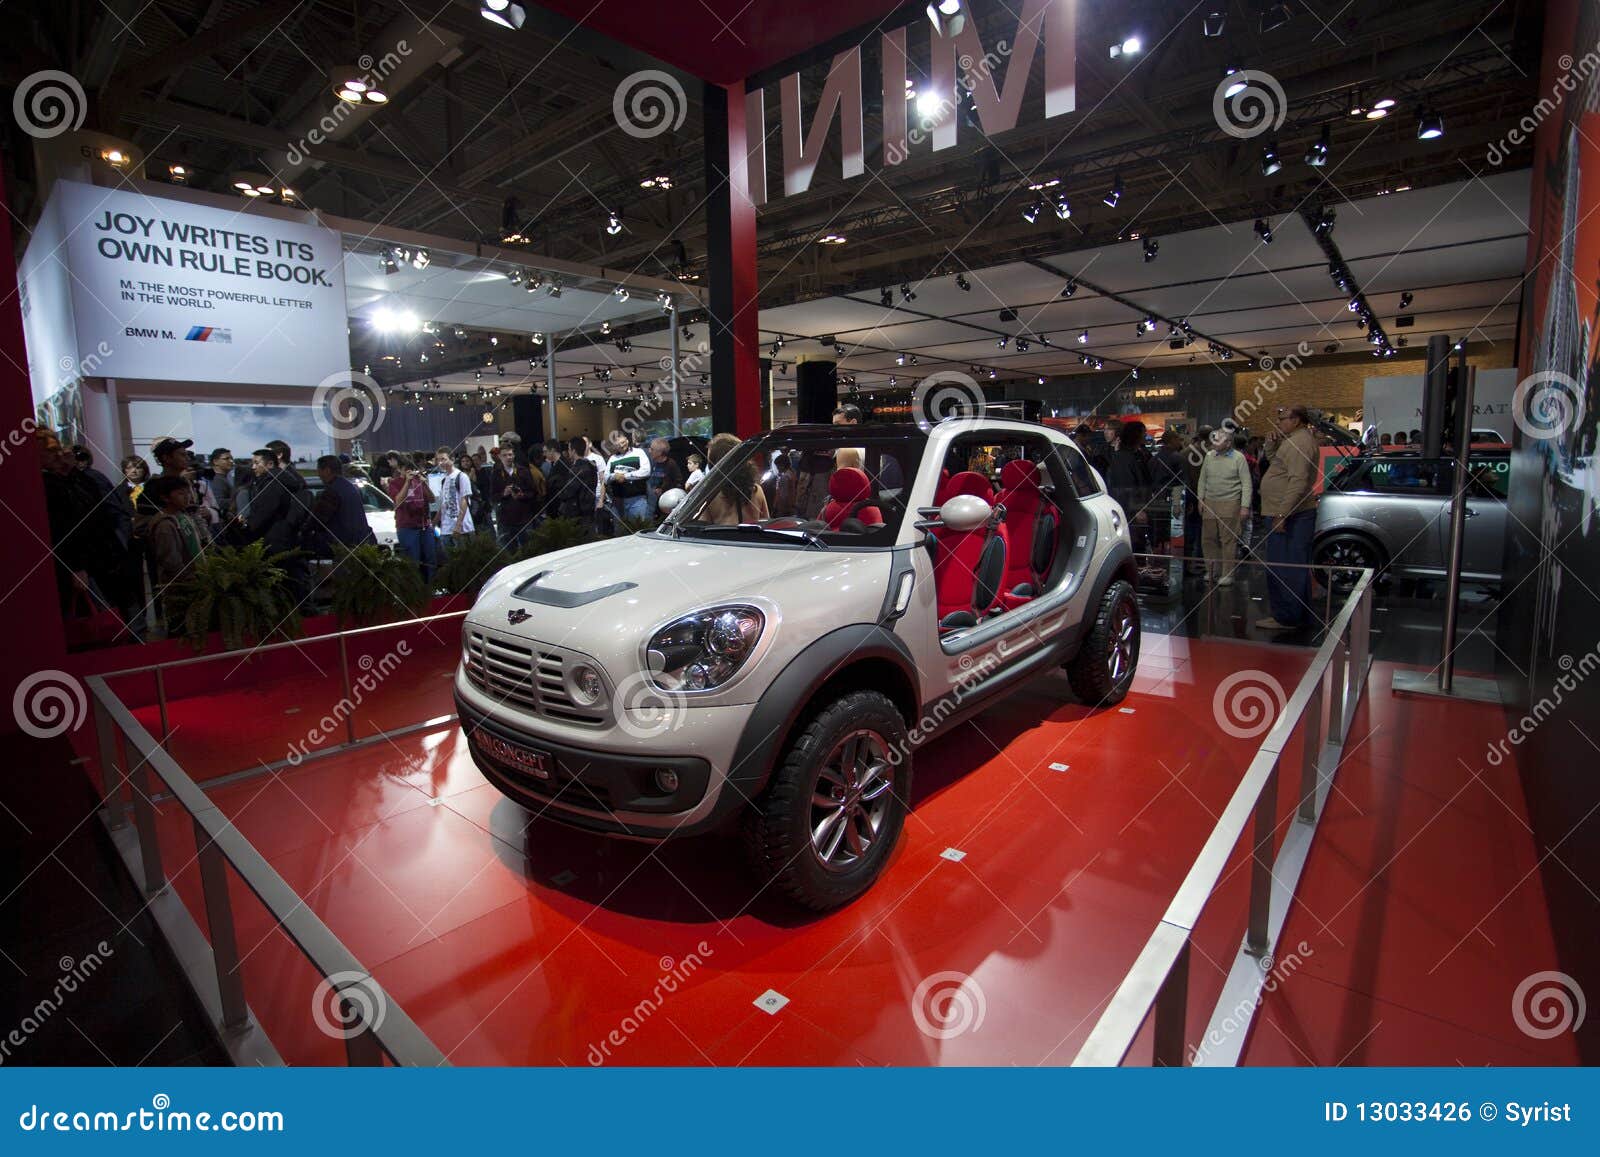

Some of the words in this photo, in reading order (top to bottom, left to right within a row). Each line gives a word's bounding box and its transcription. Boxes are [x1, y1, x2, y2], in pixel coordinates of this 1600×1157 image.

[95, 210, 155, 237] JOY
[161, 220, 269, 256] WRITES
[276, 239, 315, 262] ITS
[98, 237, 173, 267] OWN
[179, 249, 251, 277] RULE
[256, 260, 334, 288] BOOK.
[119, 280, 136, 291] M.
[138, 281, 165, 294] THE
[168, 285, 204, 298] MOST
[207, 290, 271, 305] POWERFUL
[272, 298, 313, 310] LETTER
[121, 291, 135, 301] IN
[137, 292, 164, 305] THE
[167, 297, 216, 310] WORLD.
[125, 327, 158, 339] BMW
[161, 330, 177, 341] M.
[1135, 388, 1175, 398] RAM
